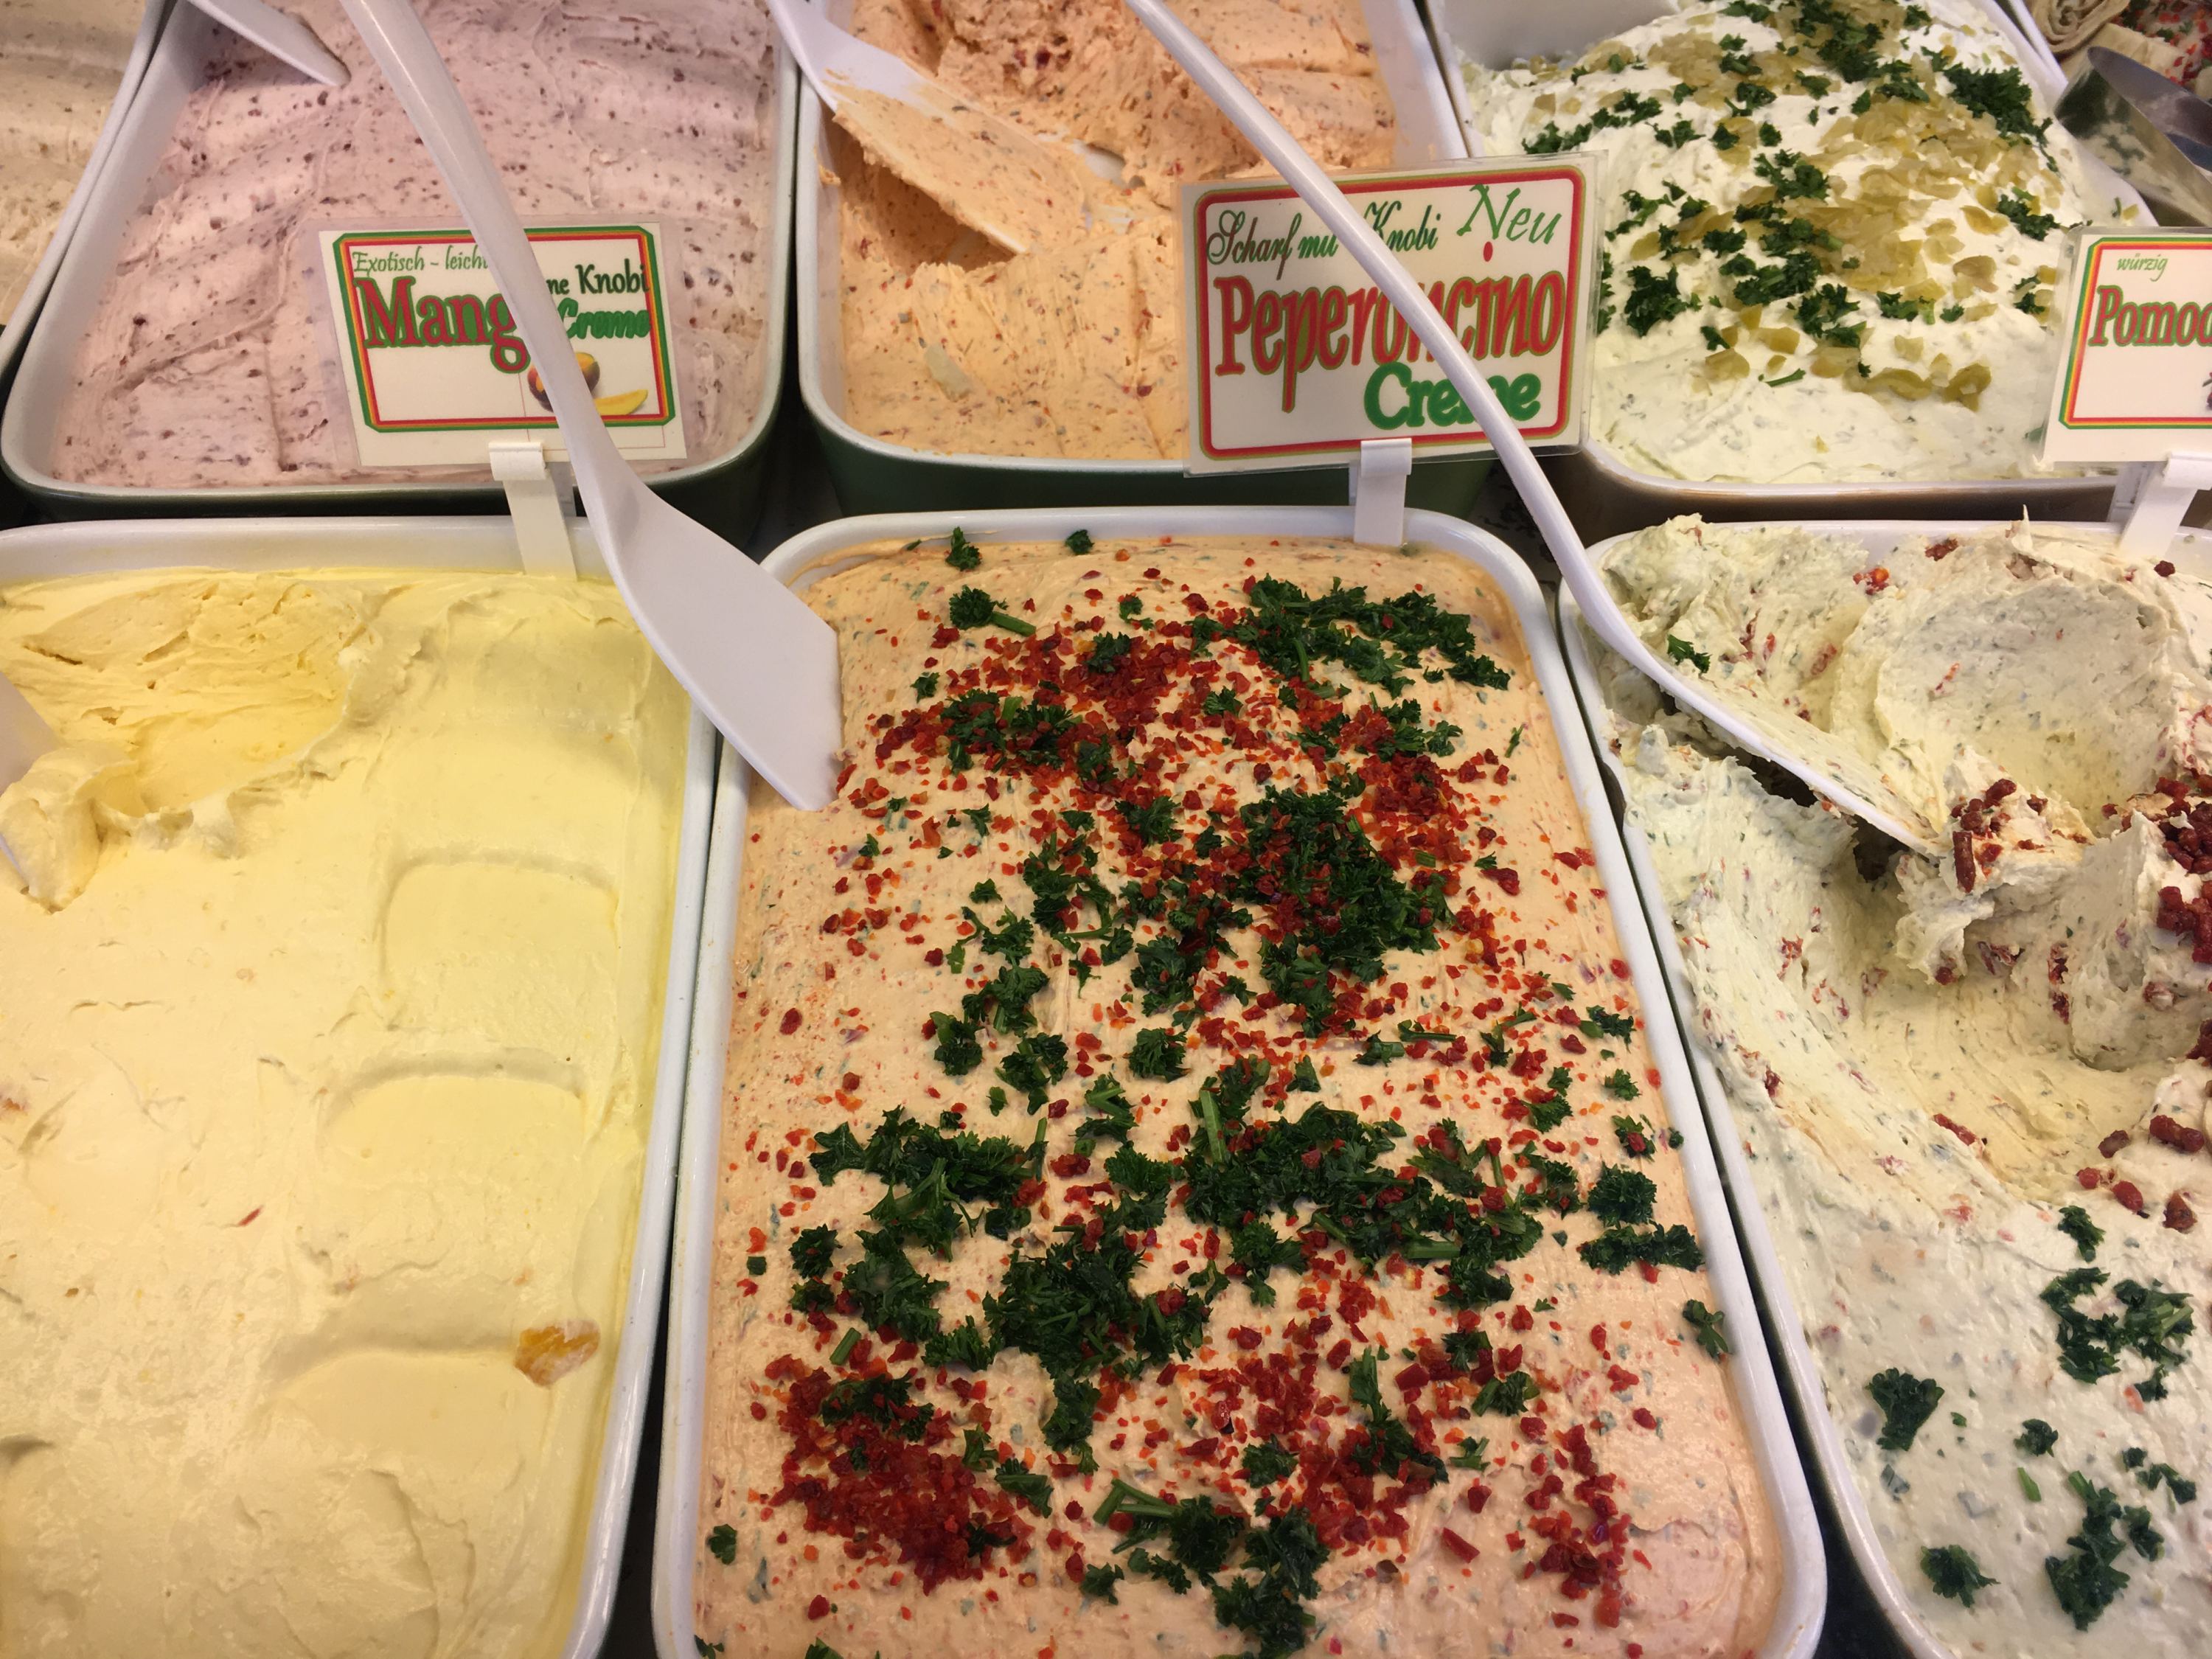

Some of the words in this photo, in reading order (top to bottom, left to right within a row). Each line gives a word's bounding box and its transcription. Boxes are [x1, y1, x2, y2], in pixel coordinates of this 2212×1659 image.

[1456, 184, 1562, 244] Neu
[352, 246, 425, 277] Exotisch
[445, 245, 488, 270] leich
[1206, 209, 1302, 281] Scharf
[1366, 201, 1441, 251] Knobi
[546, 279, 570, 295] ne
[575, 258, 650, 294] Knobi
[2117, 253, 2168, 282] würzig
[353, 276, 531, 374] Mang
